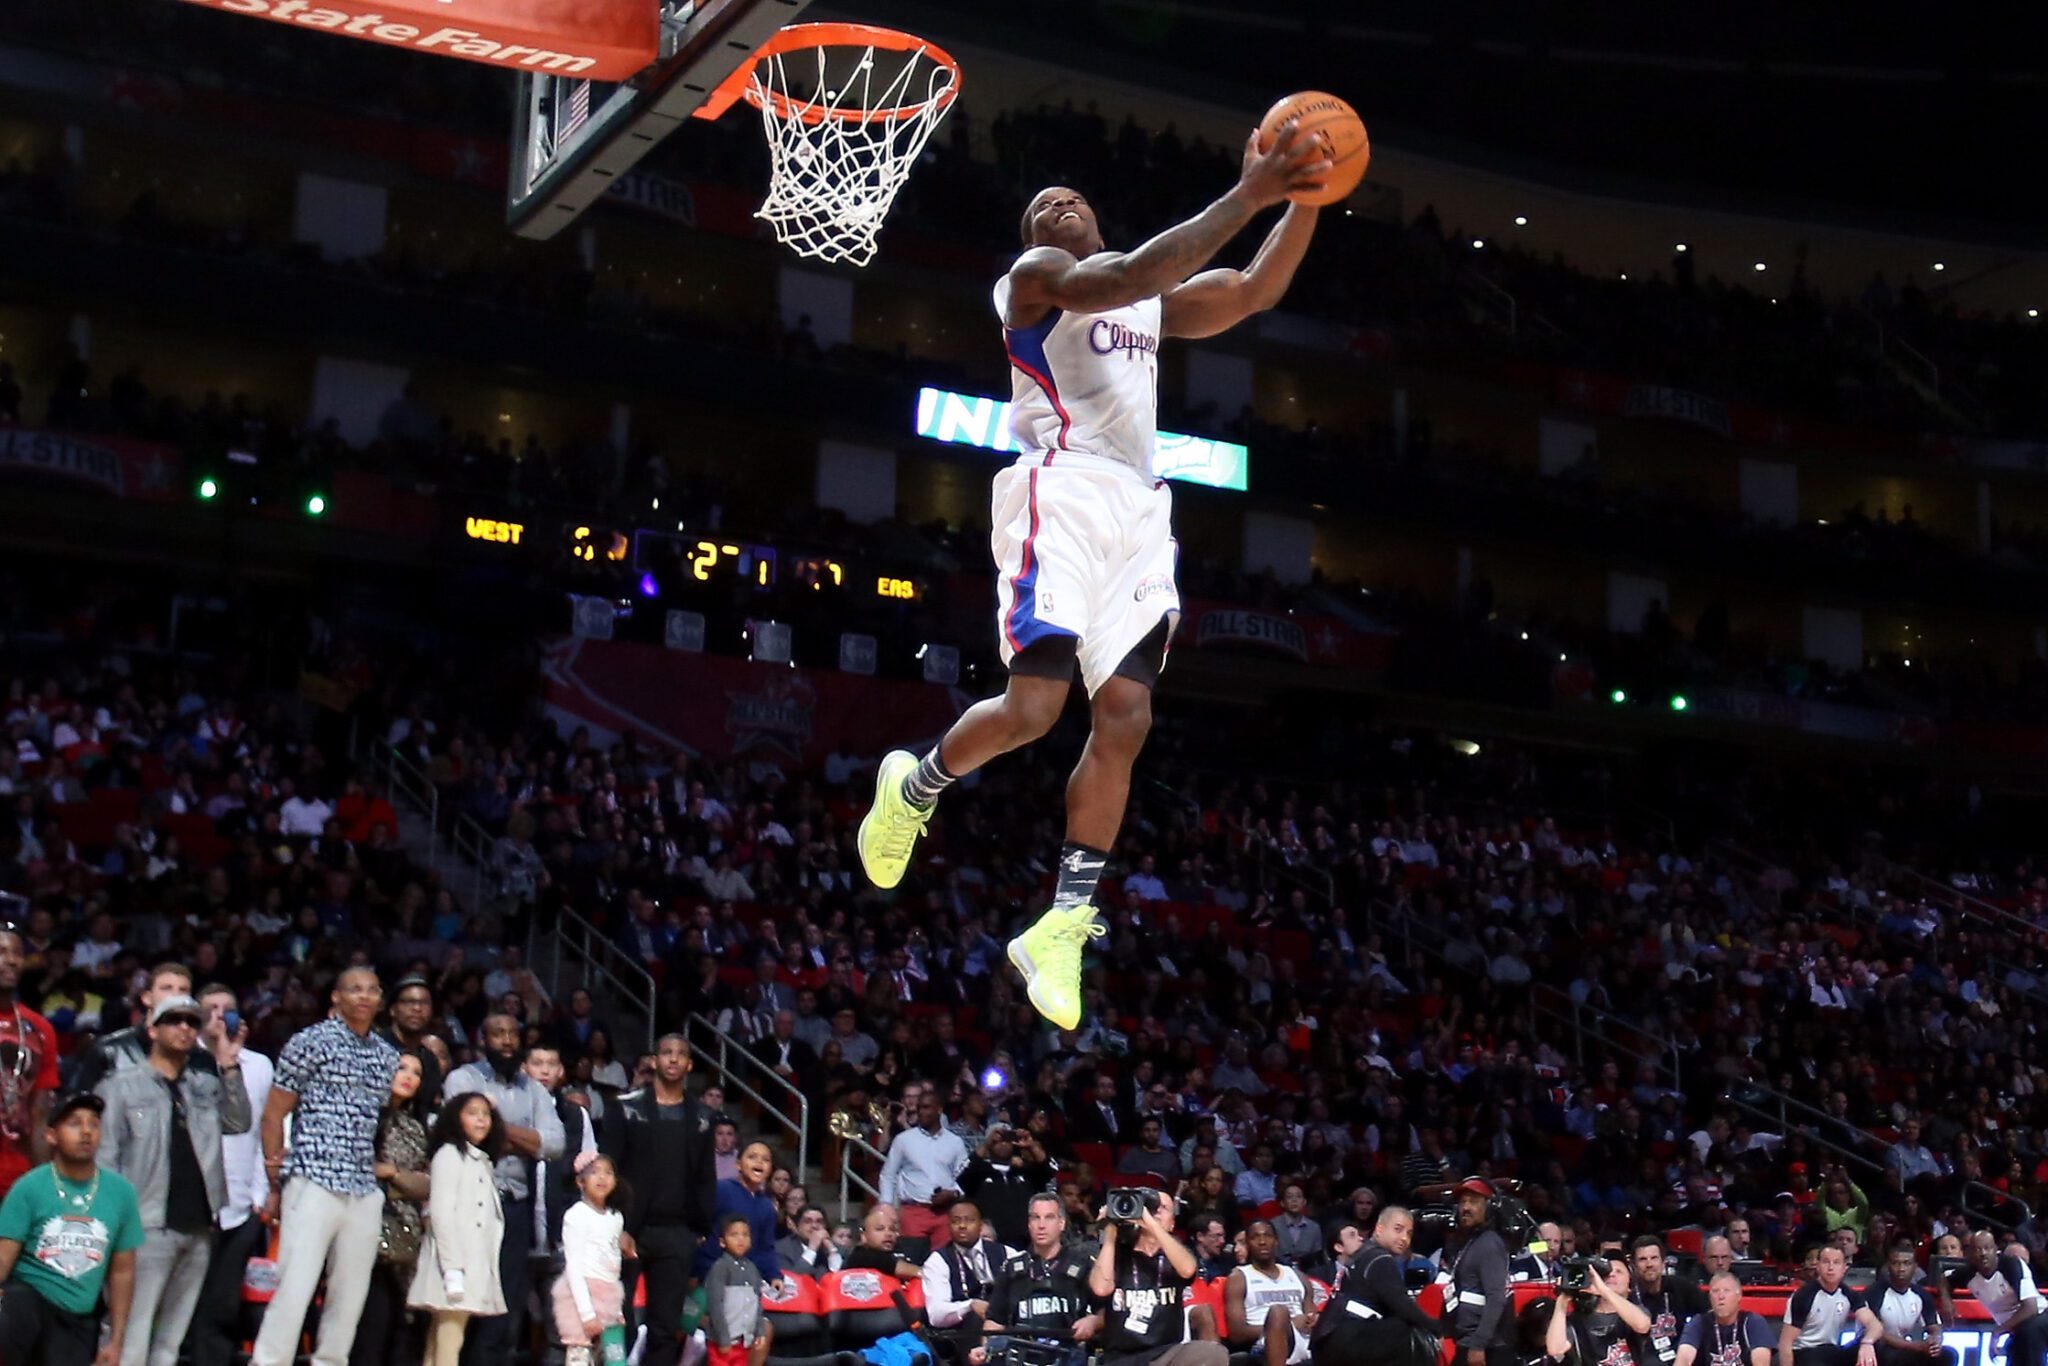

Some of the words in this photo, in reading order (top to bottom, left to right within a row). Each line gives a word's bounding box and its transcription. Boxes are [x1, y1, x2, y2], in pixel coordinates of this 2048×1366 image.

[221, 0, 420, 42] State
[416, 27, 598, 72] Farm
[1200, 612, 1304, 651] ALL-STAR
[1126, 1288, 1158, 1308] NBA
[1159, 1287, 1176, 1305] TV
